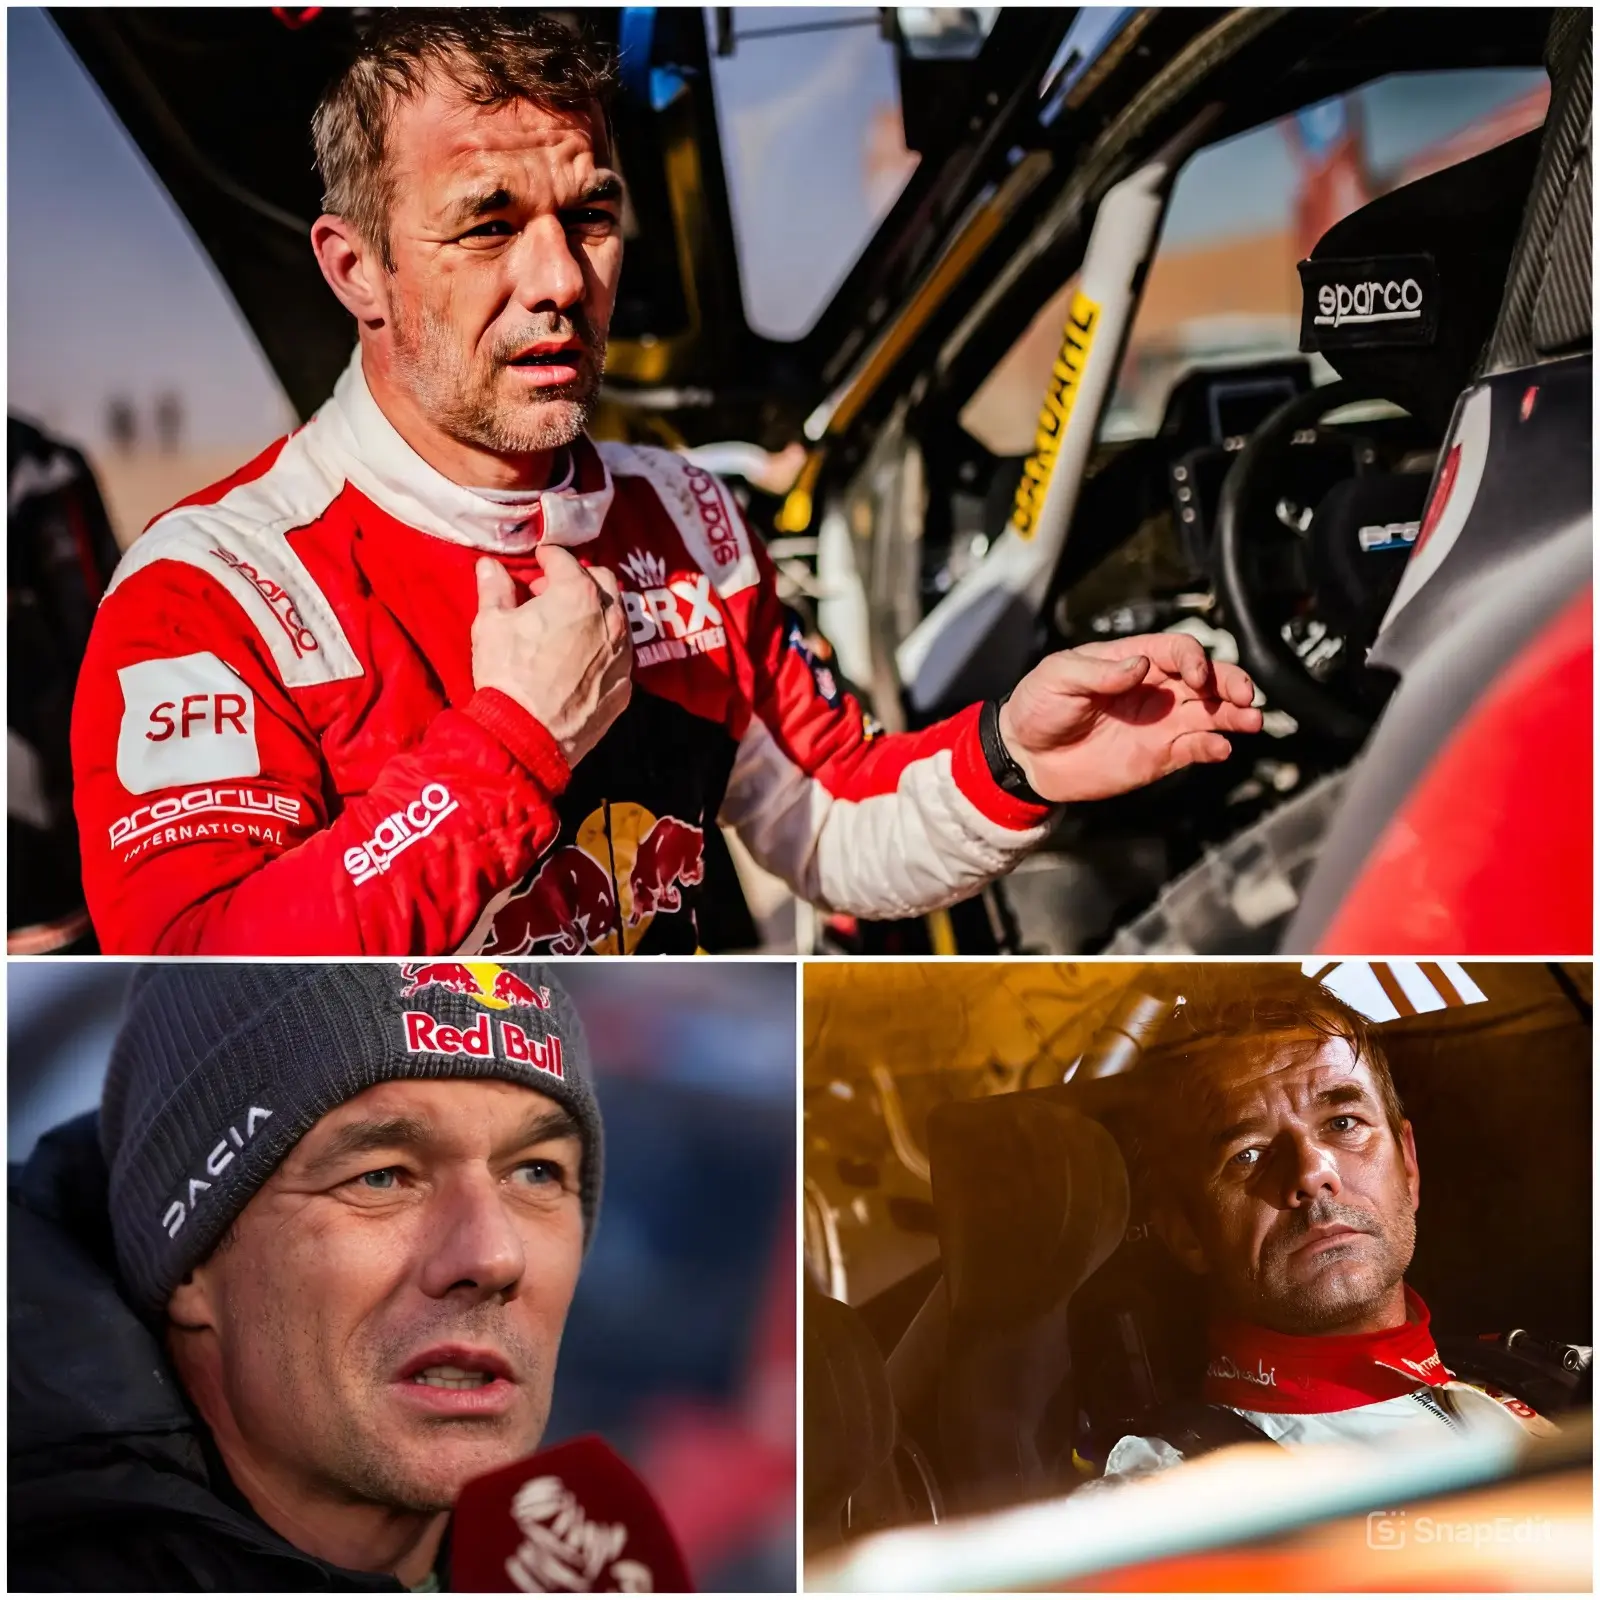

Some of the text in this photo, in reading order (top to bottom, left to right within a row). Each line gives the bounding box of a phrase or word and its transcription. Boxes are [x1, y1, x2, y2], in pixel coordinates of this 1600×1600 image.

[1314, 278, 1423, 328] sparco
[209, 547, 319, 658] sparco
[621, 574, 723, 645] BRX
[145, 694, 248, 742] SFR
[108, 788, 300, 850] prodrive
[124, 823, 283, 862] INTERNATIONAL
[343, 783, 459, 887] sparco
[403, 1011, 564, 1081] Red Bull
[162, 1106, 273, 1239] DACIA
